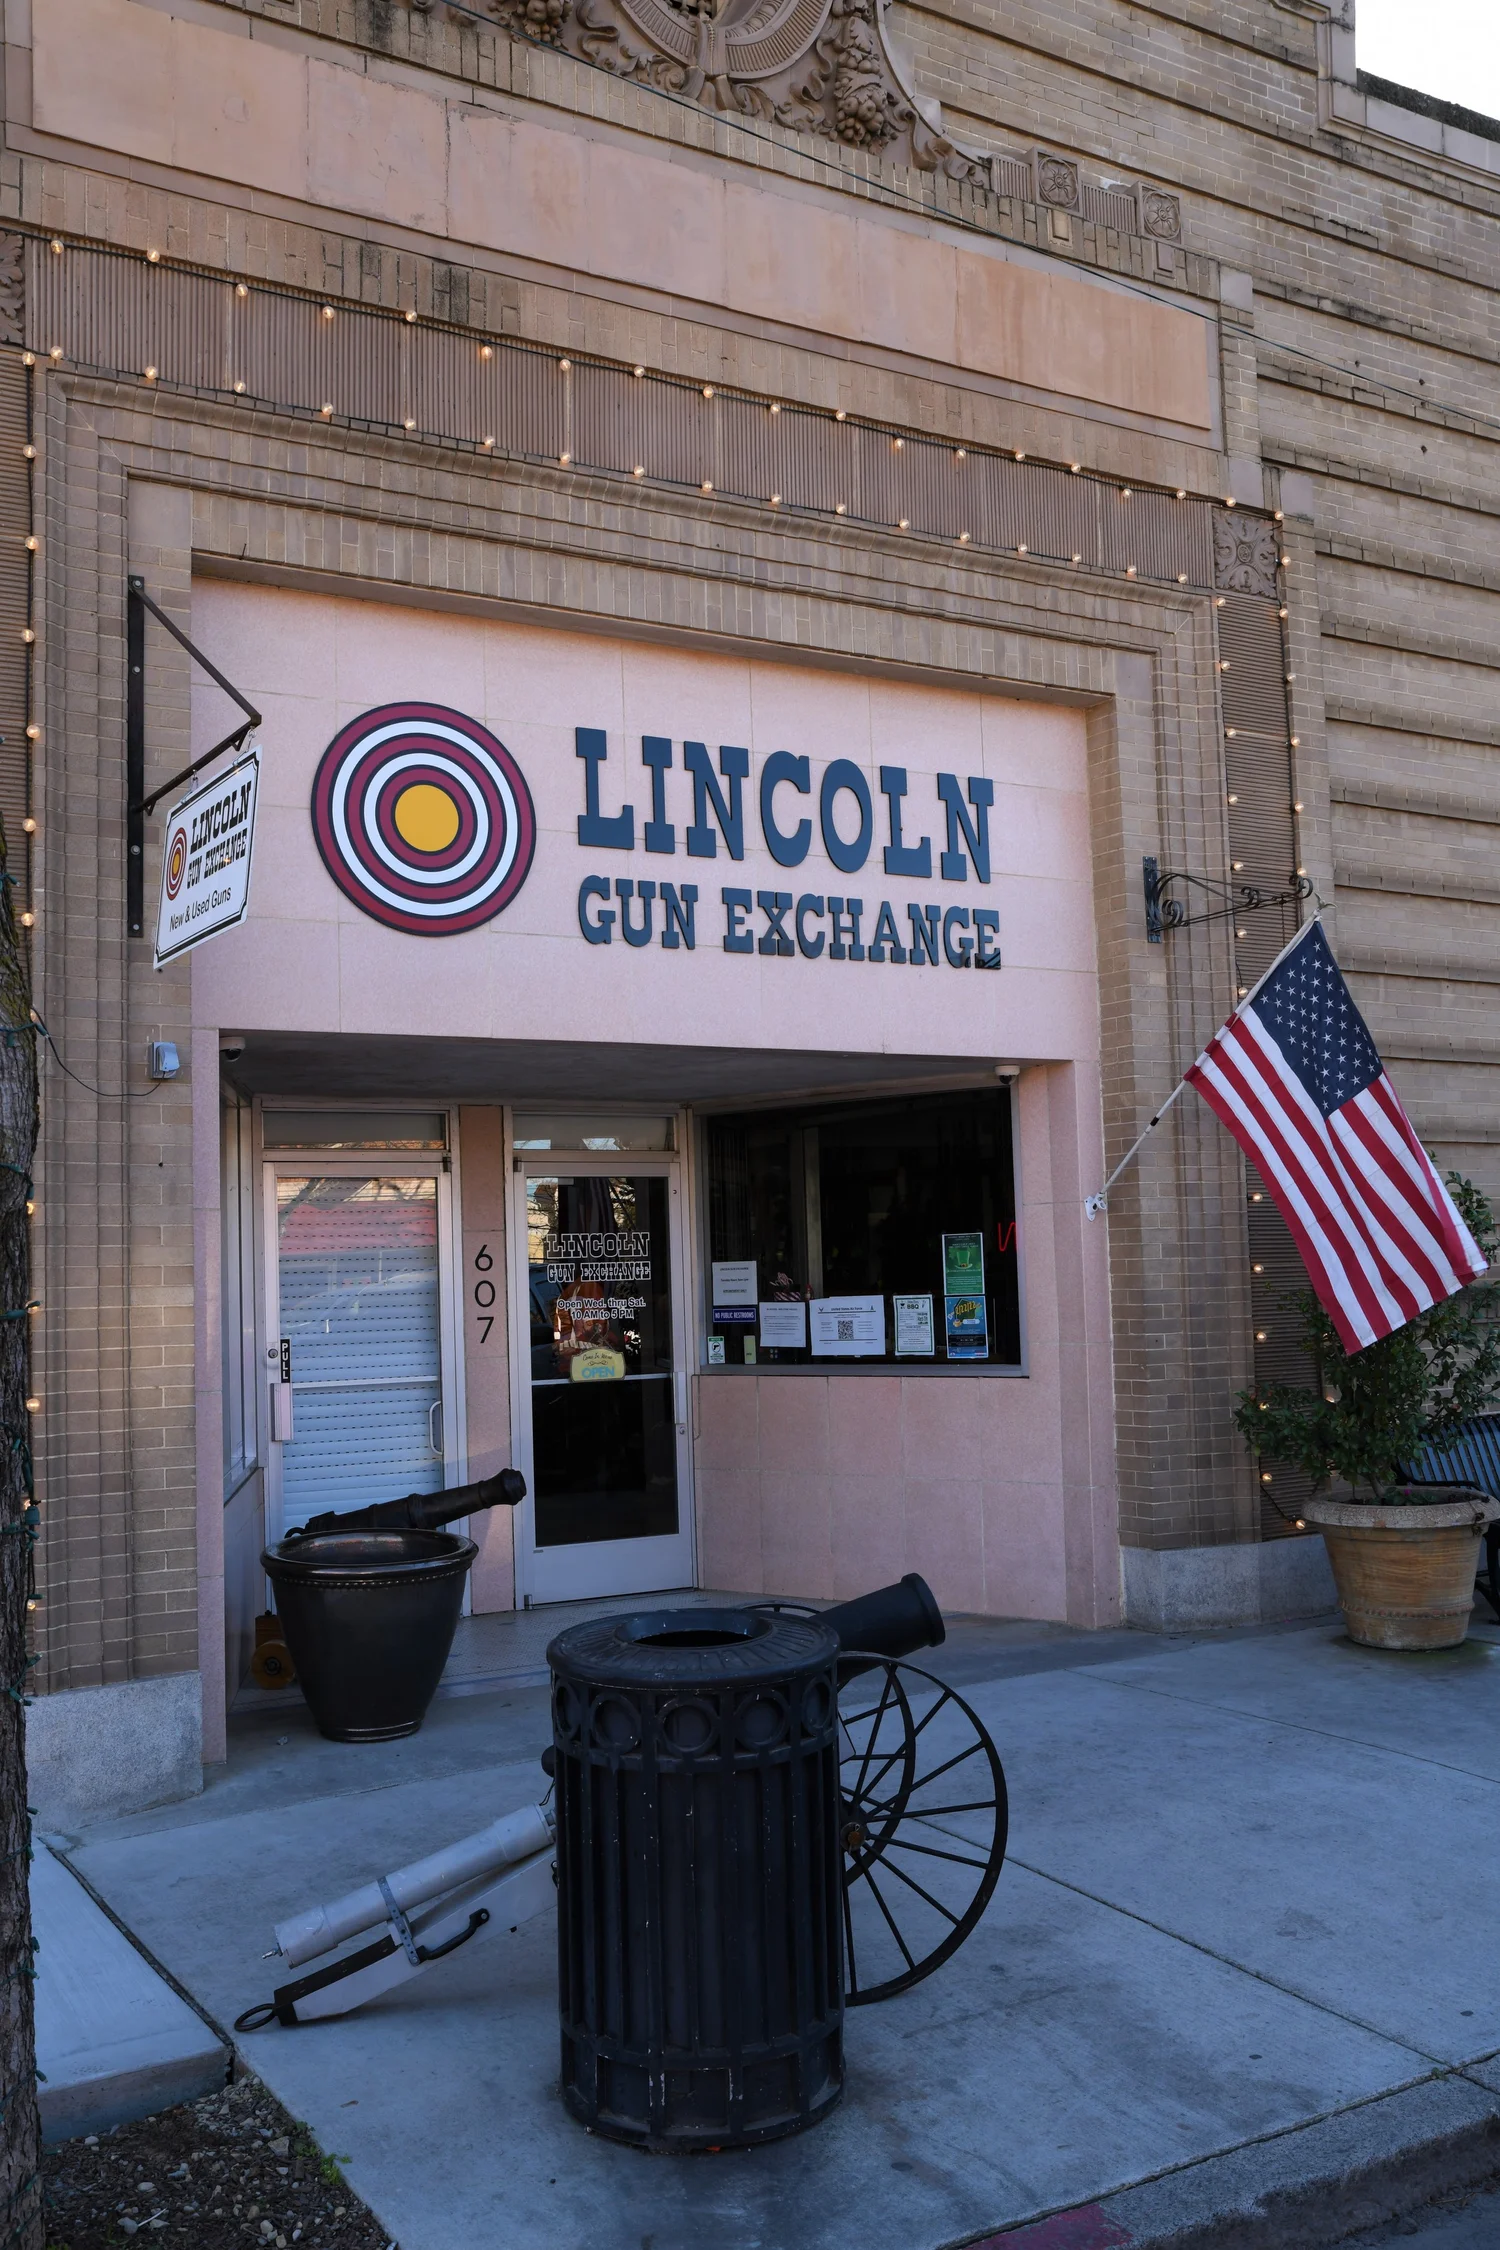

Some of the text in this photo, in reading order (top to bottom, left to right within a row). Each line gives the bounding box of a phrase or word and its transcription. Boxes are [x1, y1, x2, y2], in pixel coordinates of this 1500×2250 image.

[190, 780, 252, 854] LINCOLN
[575, 726, 994, 884] LINCOLN
[187, 827, 248, 889] GUN EXCHANGE
[169, 886, 232, 932] New & Used Guns
[578, 874, 1002, 971] GUN EXCHANGE
[546, 1232, 650, 1259] LINCOLN
[547, 1261, 651, 1283] GUN EXCHANGE
[474, 1244, 496, 1344] 607
[557, 1296, 646, 1310] Open Wed. thru Sat.
[571, 1308, 634, 1320] 10 AM to 5 PM
[733, 1311, 754, 1319] RESTROOMS
[581, 1364, 615, 1379] OPEN
